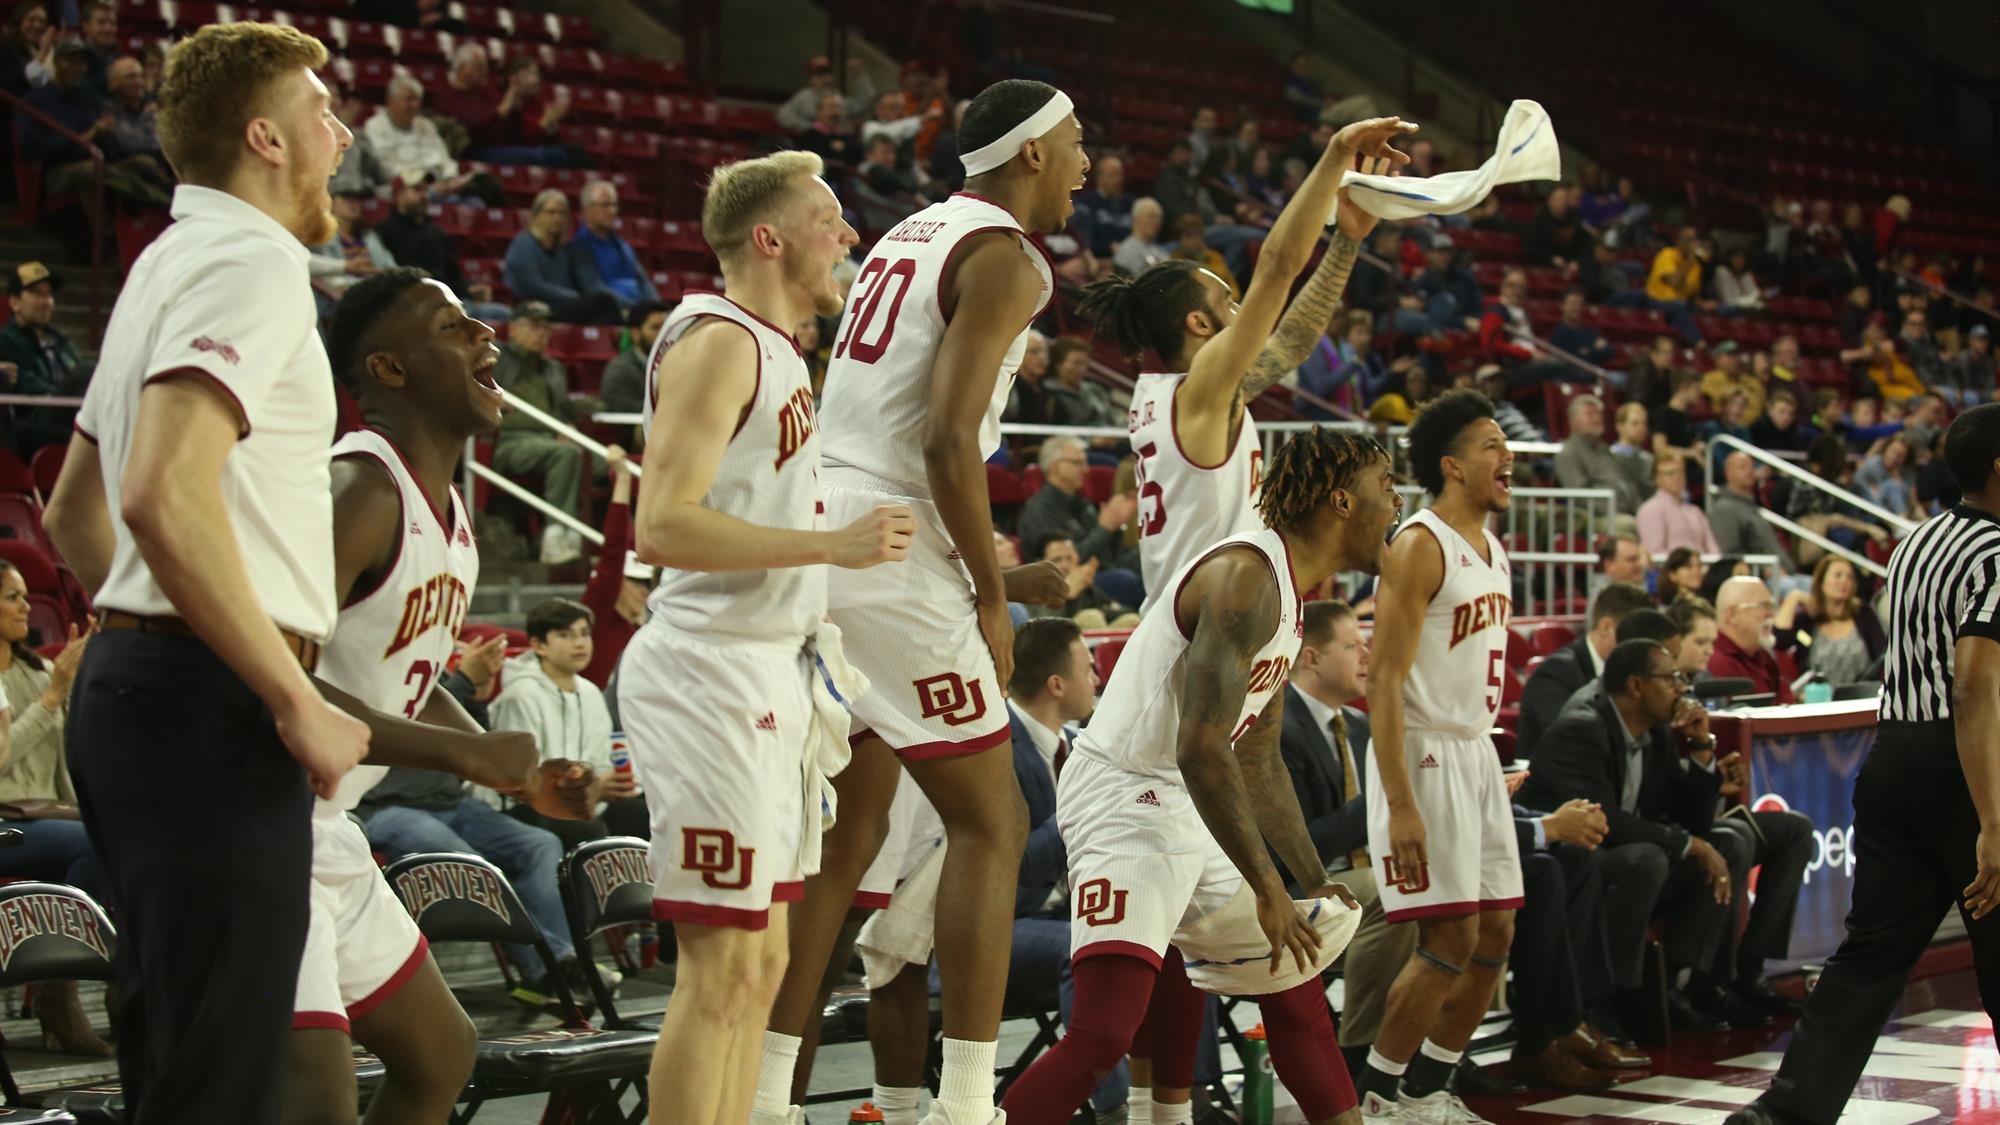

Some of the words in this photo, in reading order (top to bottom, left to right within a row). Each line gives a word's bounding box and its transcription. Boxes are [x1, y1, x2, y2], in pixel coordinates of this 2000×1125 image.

[835, 256, 917, 365] 30
[912, 671, 988, 727] DU
[1485, 649, 1504, 715] 5
[680, 826, 757, 891] DU
[395, 861, 512, 926] DENVER
[1076, 877, 1130, 928] DU
